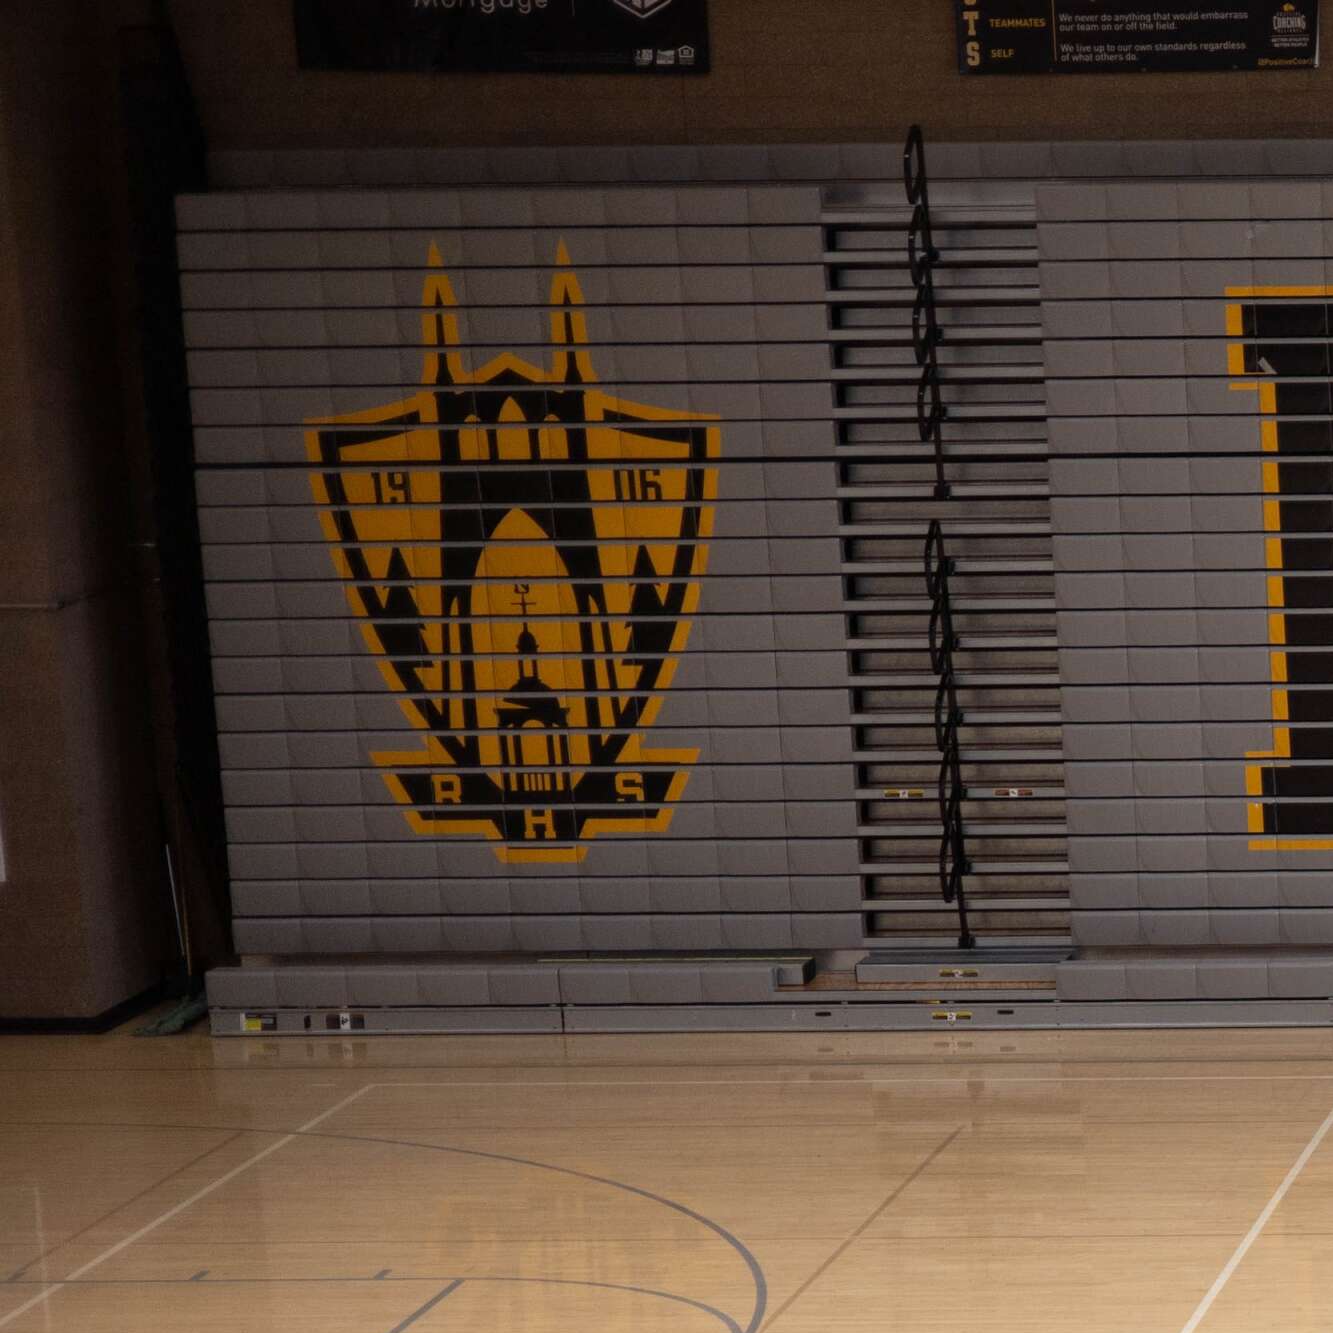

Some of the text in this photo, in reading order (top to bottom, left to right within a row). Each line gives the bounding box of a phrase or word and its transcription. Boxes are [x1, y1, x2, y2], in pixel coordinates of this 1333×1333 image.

[1058, 13, 1073, 22] We
[1075, 14, 1098, 22] never
[1101, 13, 1112, 22] do
[989, 18, 1047, 28] TEAMMATES
[1060, 43, 1074, 52] We
[991, 48, 1015, 58] SELF
[371, 471, 412, 504] 19
